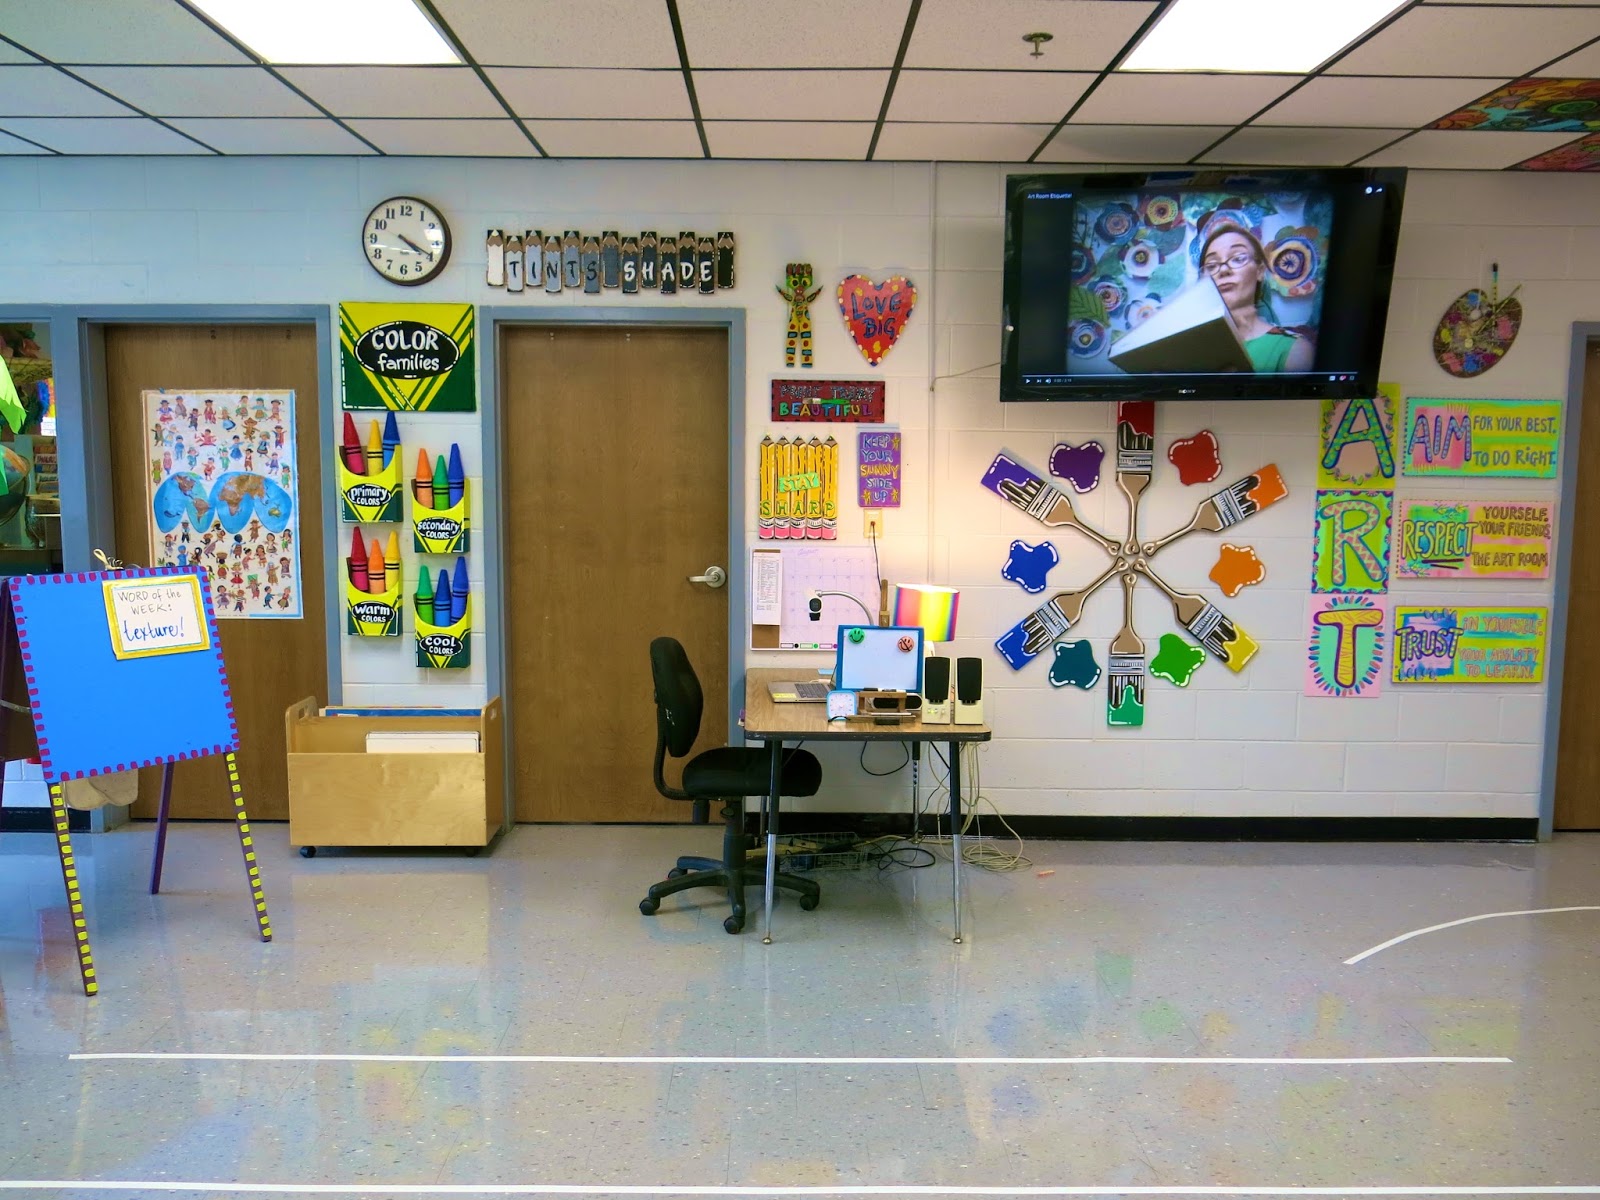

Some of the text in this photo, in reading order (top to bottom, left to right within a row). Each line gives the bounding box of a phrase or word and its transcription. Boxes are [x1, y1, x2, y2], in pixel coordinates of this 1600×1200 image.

[385, 208, 395, 219] 11
[400, 205, 412, 216] 12
[420, 210, 425, 221] 1
[374, 219, 387, 230] 10
[370, 233, 378, 244] 9
[375, 248, 382, 259] 8
[426, 251, 434, 262] 4
[386, 260, 393, 270] 7
[400, 264, 408, 275] 6
[415, 261, 422, 272] 5
[509, 260, 713, 282] TINTS SHADE
[851, 292, 902, 320] LOVE
[862, 317, 896, 340] BIG
[371, 329, 440, 351] COLOR
[377, 353, 440, 371] families
[779, 402, 873, 417] BEAUTIFUL
[1473, 415, 1557, 434] FOR YOUR BEST.
[863, 434, 891, 449] KEEP
[1322, 399, 1395, 478] A
[1407, 414, 1472, 463] AIM
[861, 449, 893, 463] YOUR
[1473, 450, 1489, 467] TO
[1492, 450, 1511, 466] DO
[859, 464, 899, 479] SUNNY
[783, 473, 817, 492] STAY
[866, 478, 892, 490] SIDE
[350, 486, 388, 501] primary
[873, 491, 888, 502] UP
[356, 498, 381, 506] COLORS
[760, 501, 835, 517] SHARP
[1483, 506, 1549, 522] YOURSELF.
[417, 519, 460, 534] secondary
[1477, 521, 1506, 535] YOUR
[425, 531, 450, 540] COLORS
[1318, 499, 1386, 587] R
[1400, 519, 1480, 561] RESPECT
[1472, 551, 1549, 567] THE ART ROOM
[118, 587, 181, 603] WORD of the
[130, 603, 173, 615] WEEK:
[354, 604, 391, 616] warm
[361, 614, 386, 623] COLORS
[123, 616, 185, 642] texture!
[1483, 616, 1544, 637] YOURSELF.
[428, 646, 454, 655] COLORS
[1313, 607, 1384, 688] T
[1395, 626, 1465, 662] TRUST
[1458, 647, 1487, 661] YOUR
[1465, 663, 1535, 679] TO LEARN.
